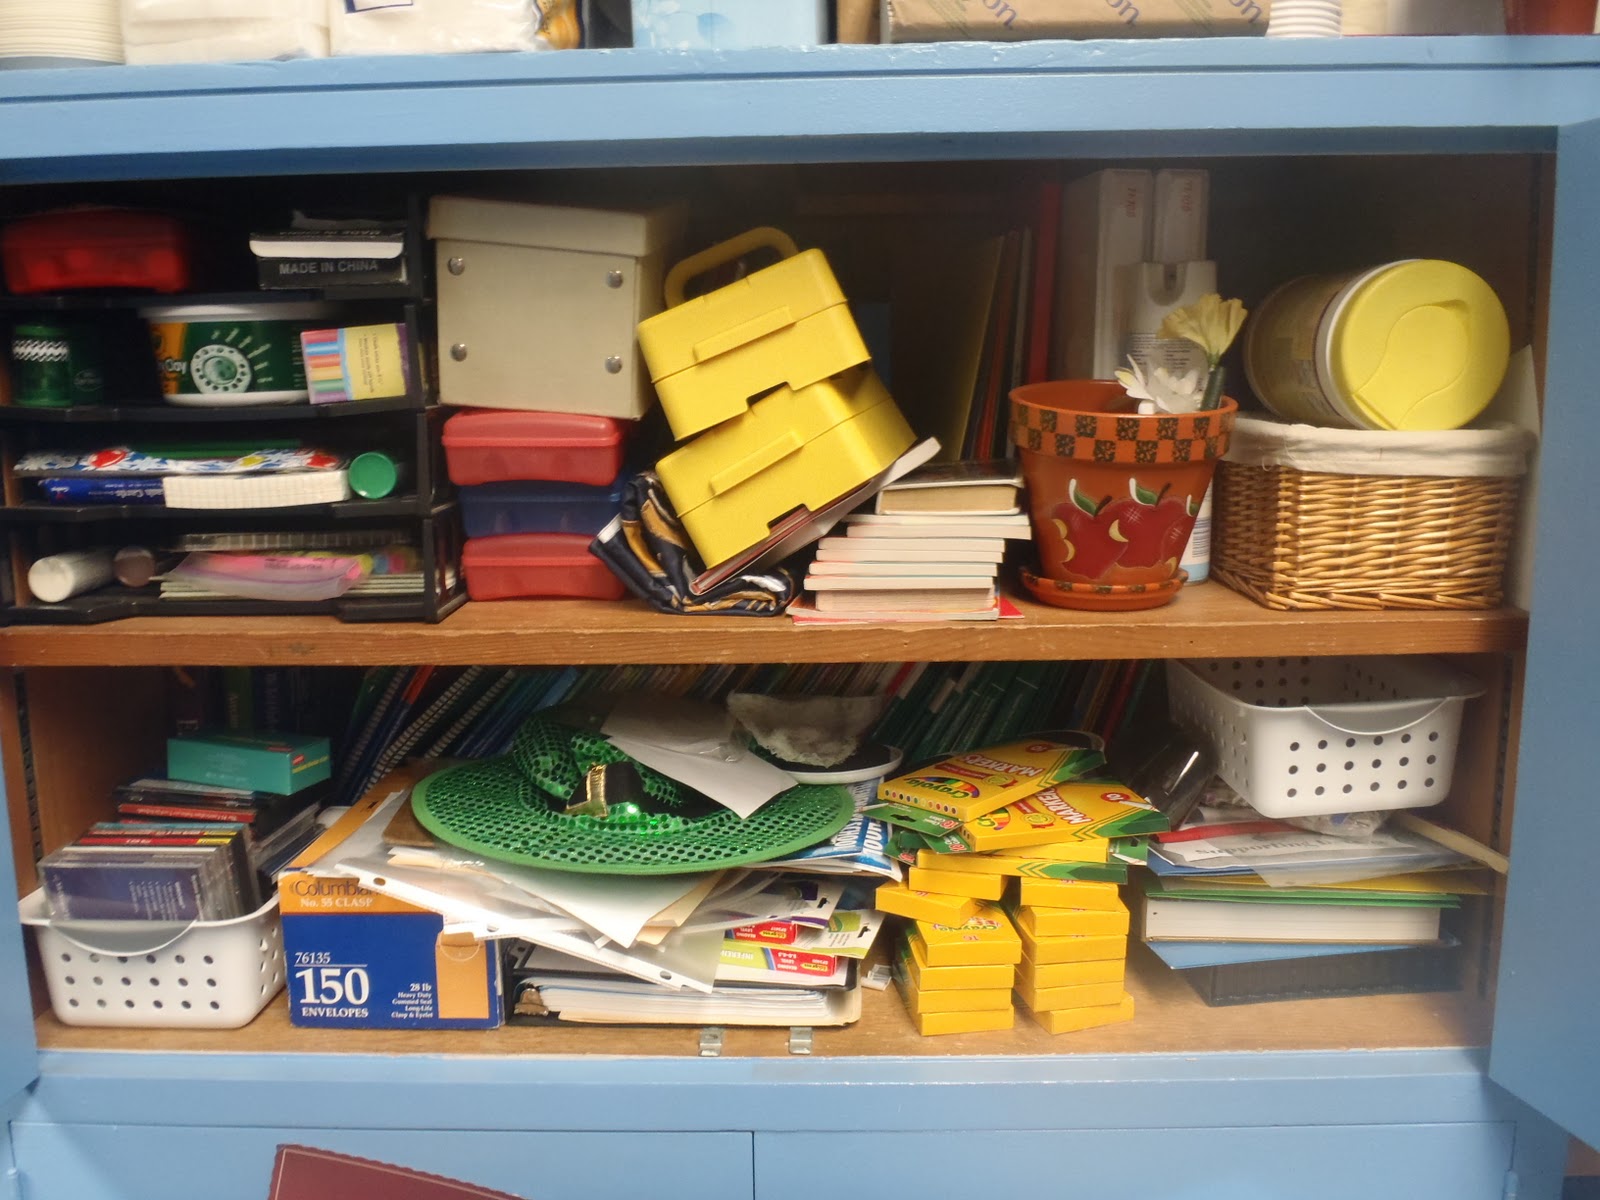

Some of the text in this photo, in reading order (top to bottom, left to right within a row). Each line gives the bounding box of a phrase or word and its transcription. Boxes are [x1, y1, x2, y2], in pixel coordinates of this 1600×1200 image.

[279, 259, 379, 275] MADE IN CHINA
[965, 754, 1045, 777] MARKERS
[906, 778, 970, 799] Crayola
[1106, 793, 1124, 801] 10
[300, 897, 374, 908] No. 55 CLASP
[294, 952, 331, 965] 76135
[295, 968, 370, 1005] 150
[410, 983, 432, 992] 28 lb
[398, 992, 432, 1000] Heavy Duty
[392, 998, 420, 1006] Gummed
[302, 1006, 369, 1018] ENVELOPES
[415, 1012, 433, 1020] Eyelet
